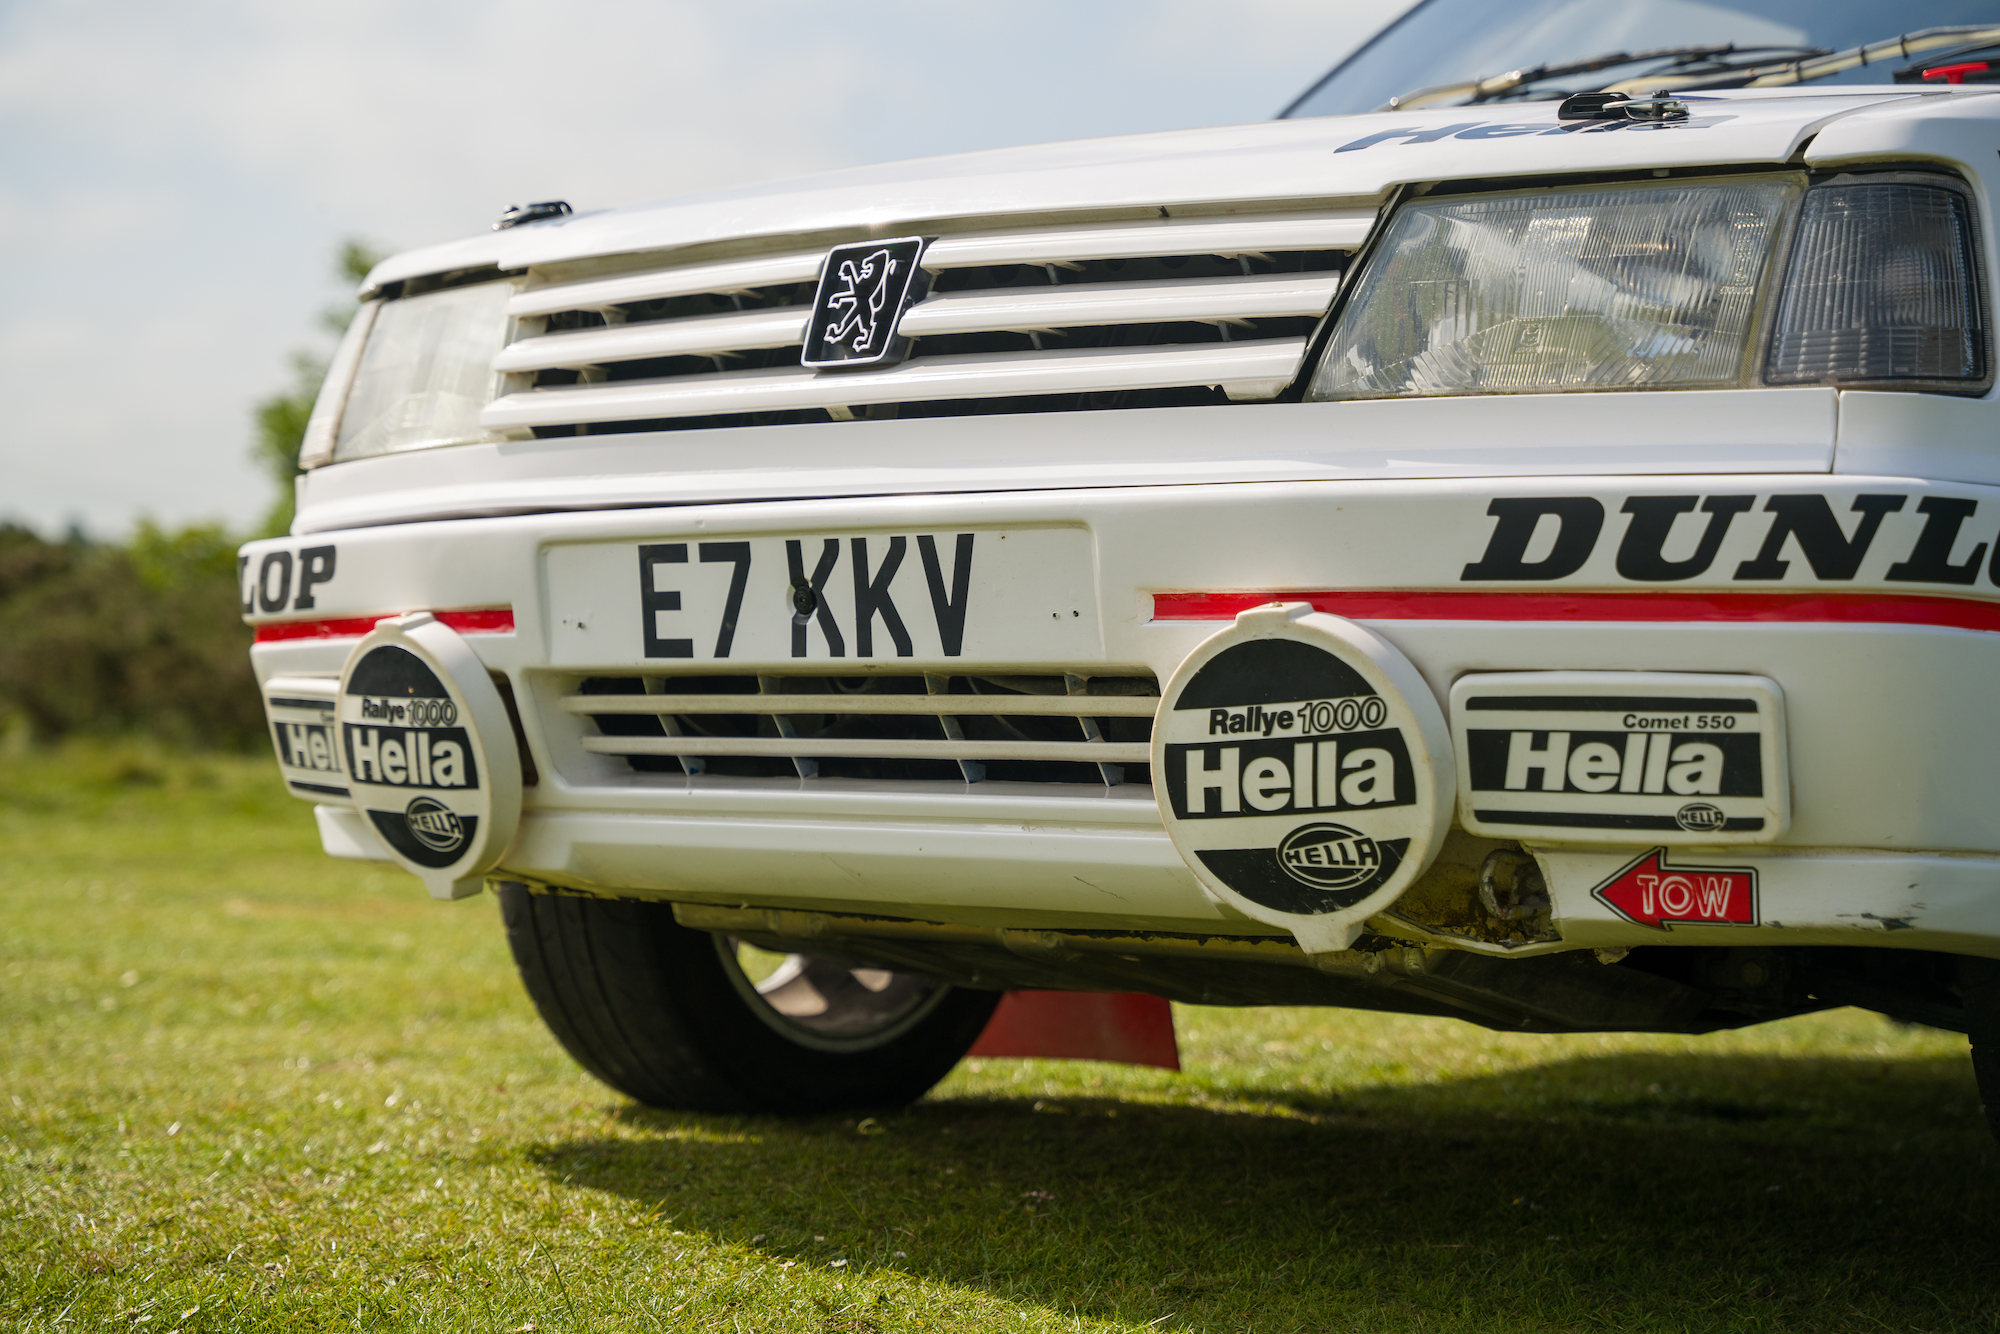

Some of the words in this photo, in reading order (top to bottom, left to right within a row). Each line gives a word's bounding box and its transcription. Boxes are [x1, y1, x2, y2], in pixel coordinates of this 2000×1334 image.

[1460, 494, 2000, 587] DUNL
[637, 541, 752, 659] E7
[785, 532, 975, 658] KKV
[361, 695, 404, 720] Rallye
[405, 699, 457, 726] 1000
[1209, 706, 1294, 736] Rallye
[1297, 697, 1387, 733] 1000
[1622, 713, 1690, 730] Comet
[1695, 715, 1736, 730] 550
[286, 724, 338, 771] Hel
[351, 726, 467, 787] Hella
[1504, 731, 1726, 796] Hella
[1186, 740, 1396, 815] Hella
[411, 811, 462, 838] HELLA
[1679, 810, 1725, 826] HELLA
[1284, 836, 1379, 868] HELLA
[1636, 874, 1733, 918] TOW
